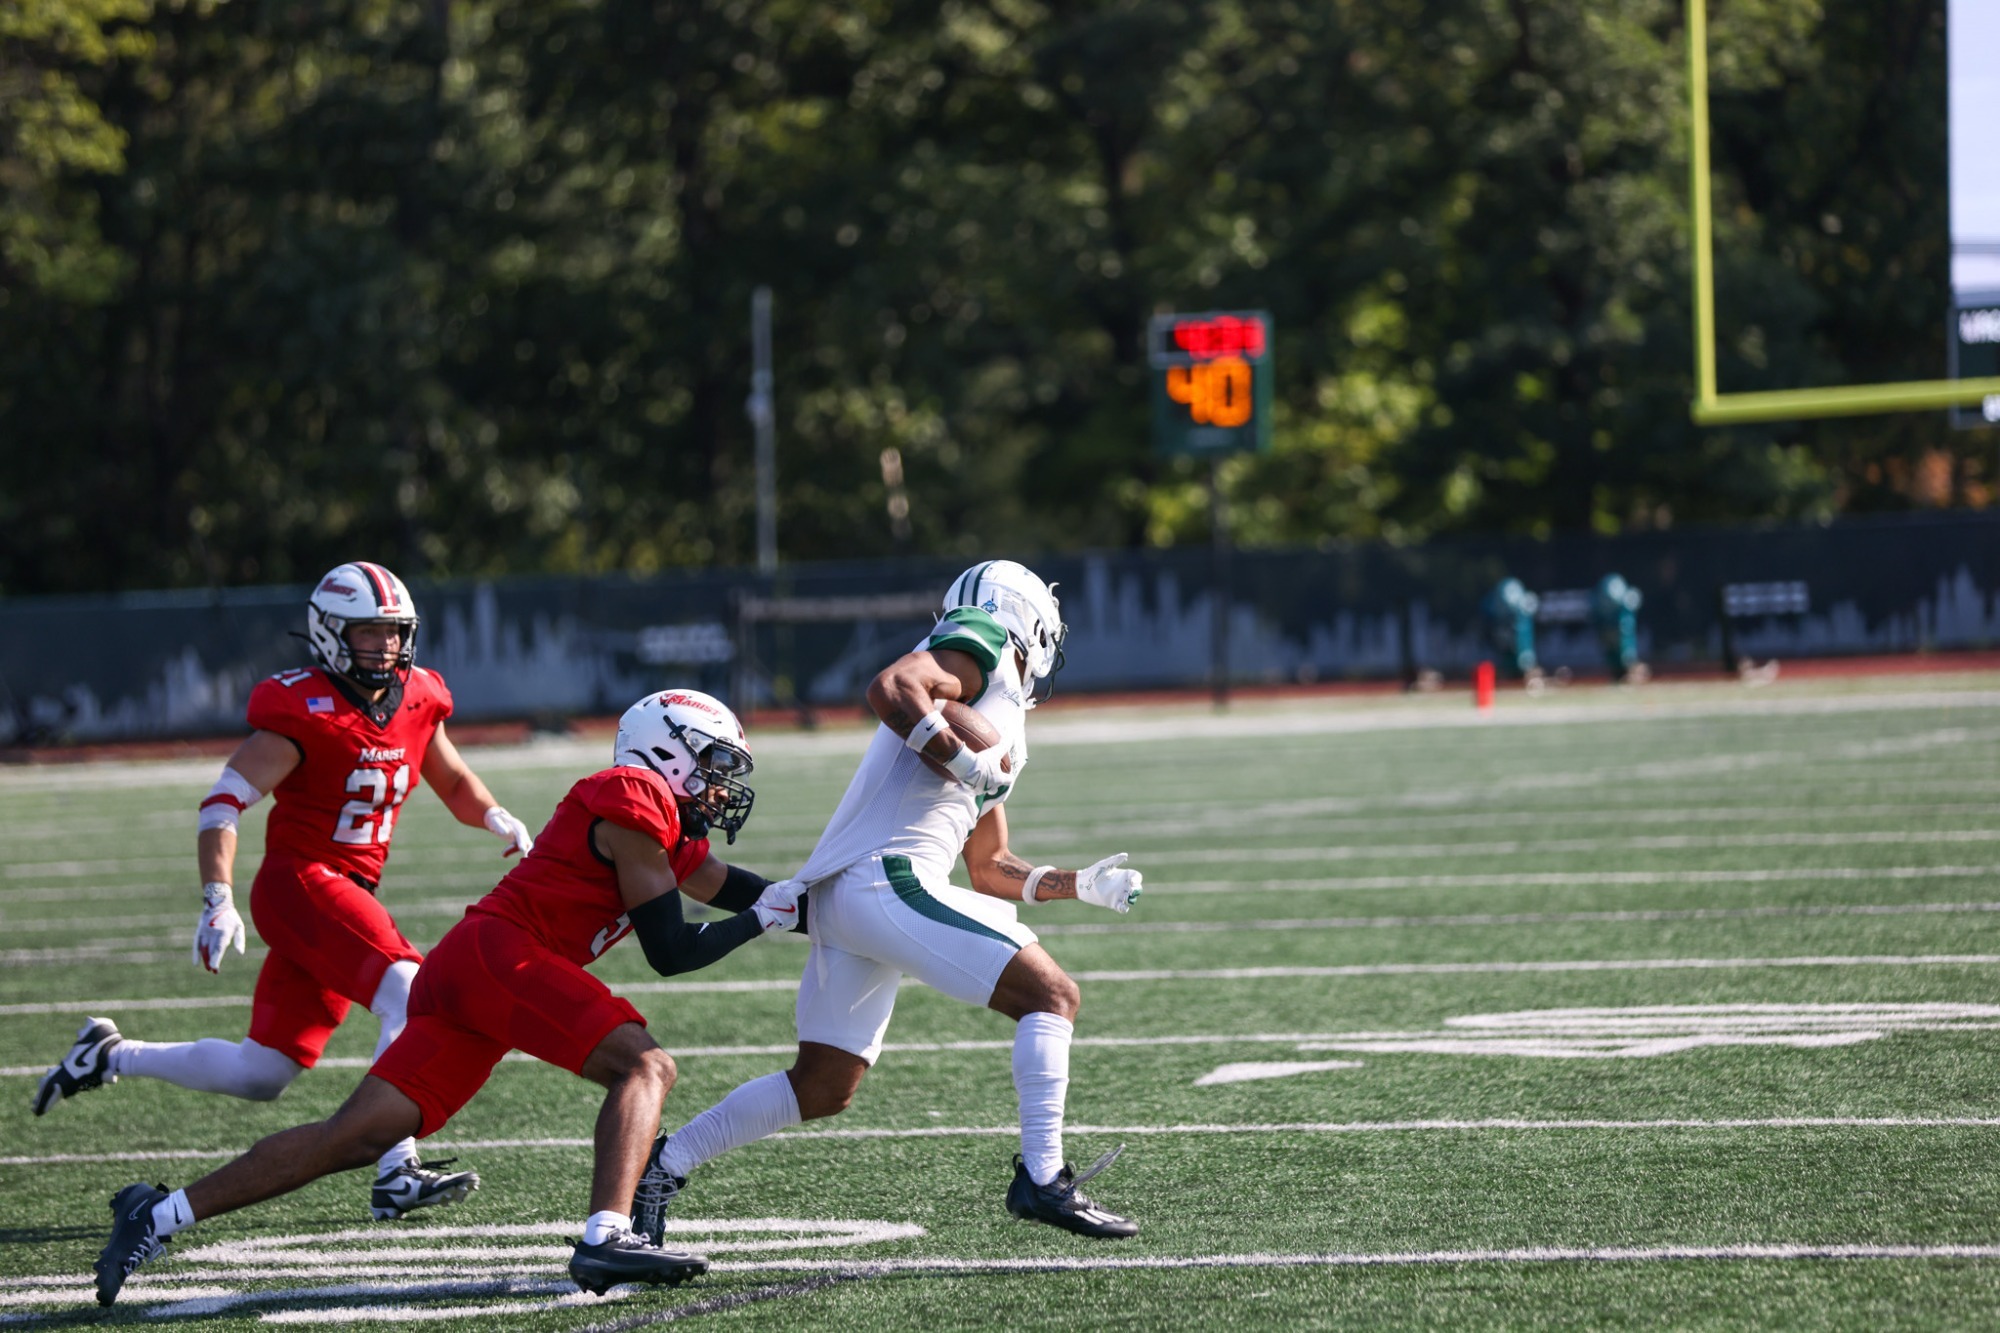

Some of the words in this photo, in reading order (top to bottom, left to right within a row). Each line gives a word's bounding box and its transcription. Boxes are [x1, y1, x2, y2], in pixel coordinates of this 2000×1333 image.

[1166, 358, 1251, 427] 40
[665, 693, 721, 715] MARIST
[358, 747, 406, 762] MARIST
[332, 764, 409, 844] 21
